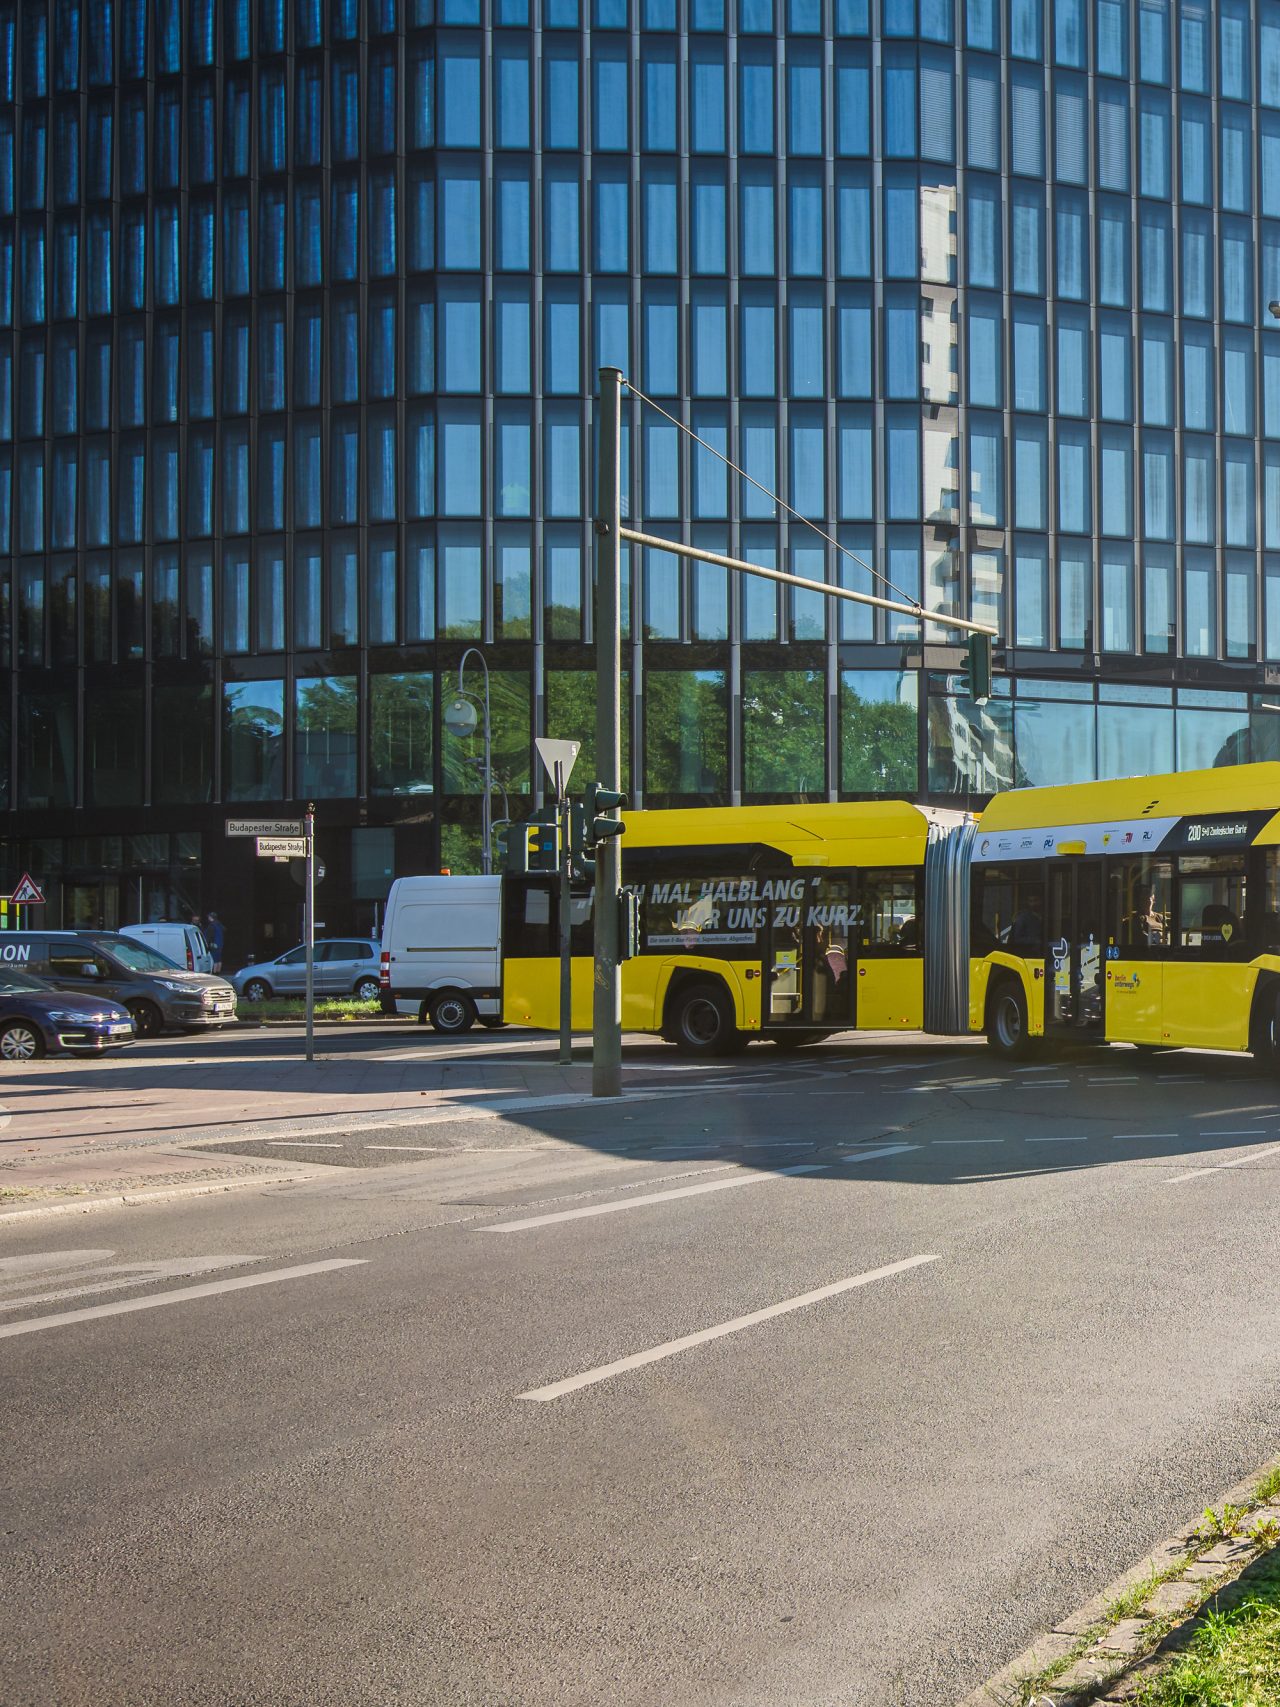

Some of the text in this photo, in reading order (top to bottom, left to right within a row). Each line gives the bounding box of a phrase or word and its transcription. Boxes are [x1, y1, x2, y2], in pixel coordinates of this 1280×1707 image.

[229, 823, 272, 834] Budapester
[1187, 824, 1202, 841] 200
[259, 842, 286, 852] Budapester
[651, 883, 693, 904] MAL
[727, 907, 767, 928] UNS
[773, 906, 800, 928] ZU
[0, 944, 31, 961] ON
